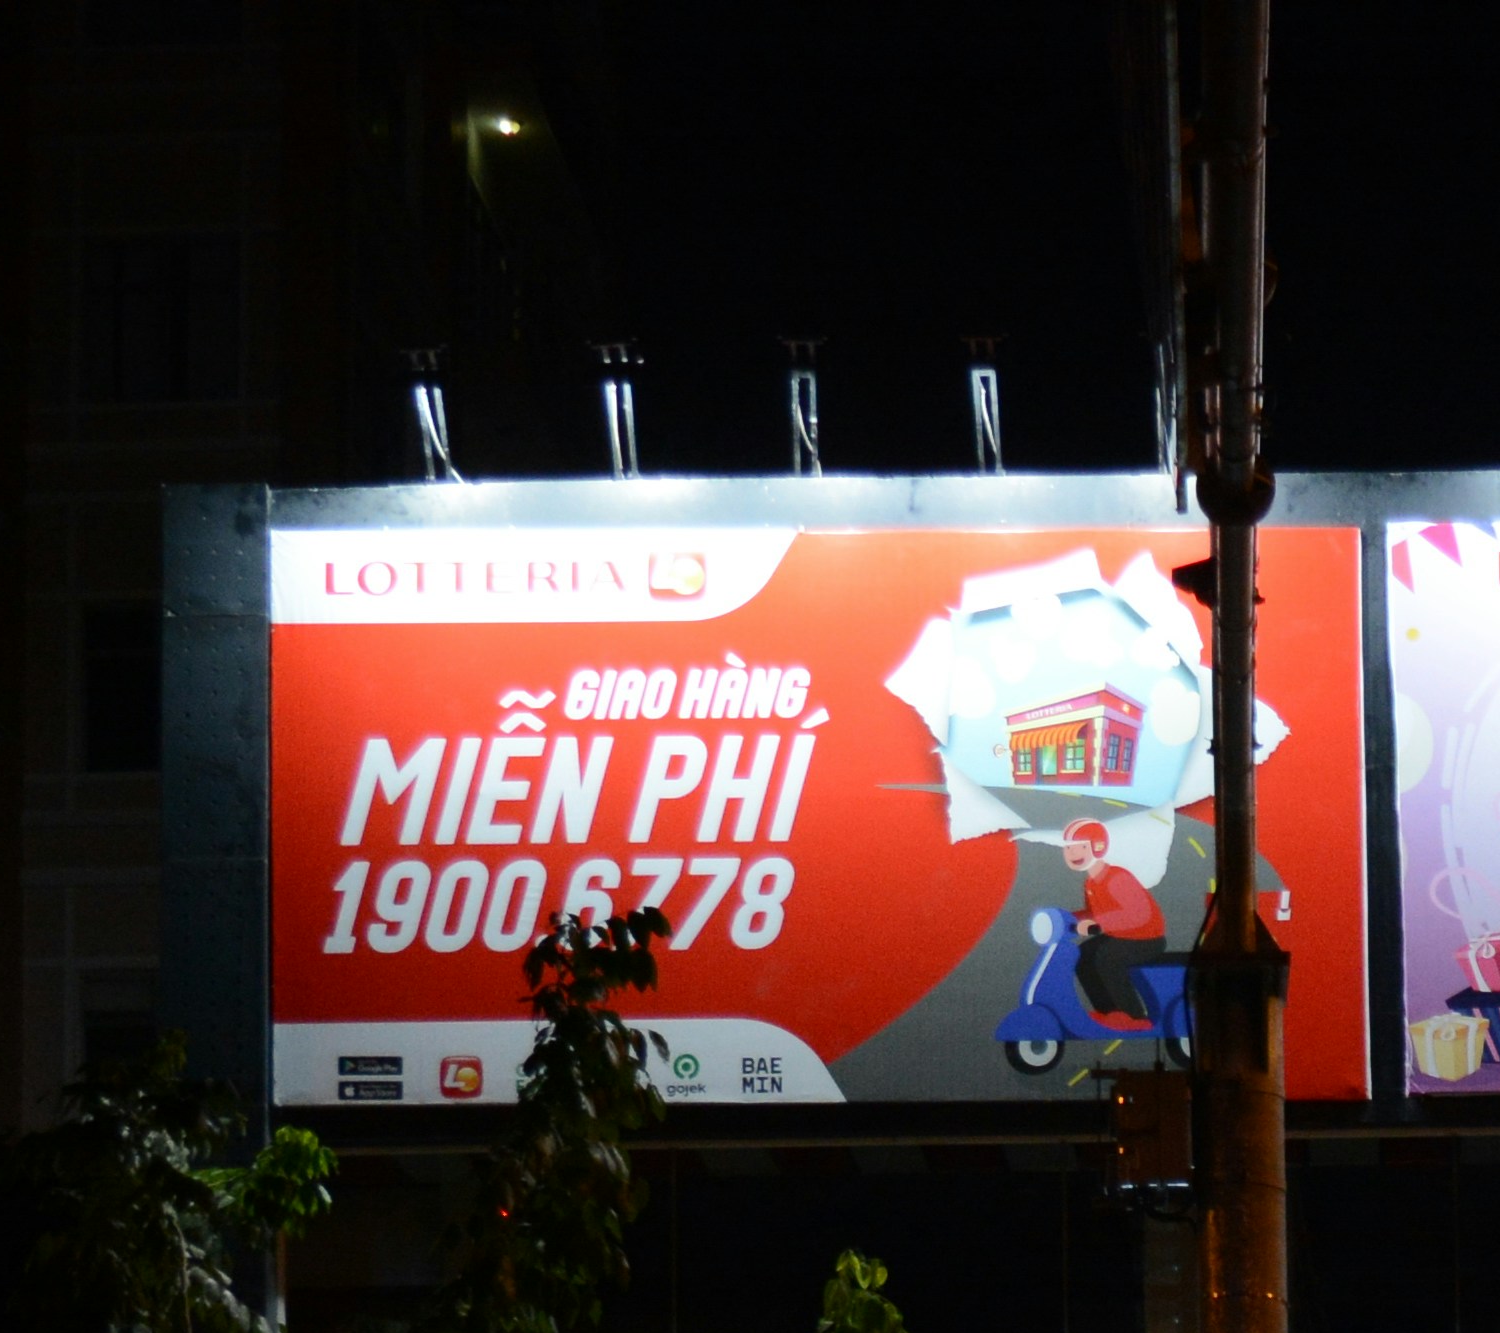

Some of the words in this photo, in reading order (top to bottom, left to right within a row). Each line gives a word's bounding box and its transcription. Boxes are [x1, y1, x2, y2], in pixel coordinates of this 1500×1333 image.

[324, 560, 626, 596] LOTTERIA
[564, 668, 677, 721] GIAO
[677, 652, 813, 720] HÀNG
[339, 690, 613, 846] MIỄN
[628, 707, 830, 842] PHÍ
[742, 1057, 782, 1074] BAE
[666, 1083, 706, 1097] gojek
[742, 1077, 783, 1093] MIN
